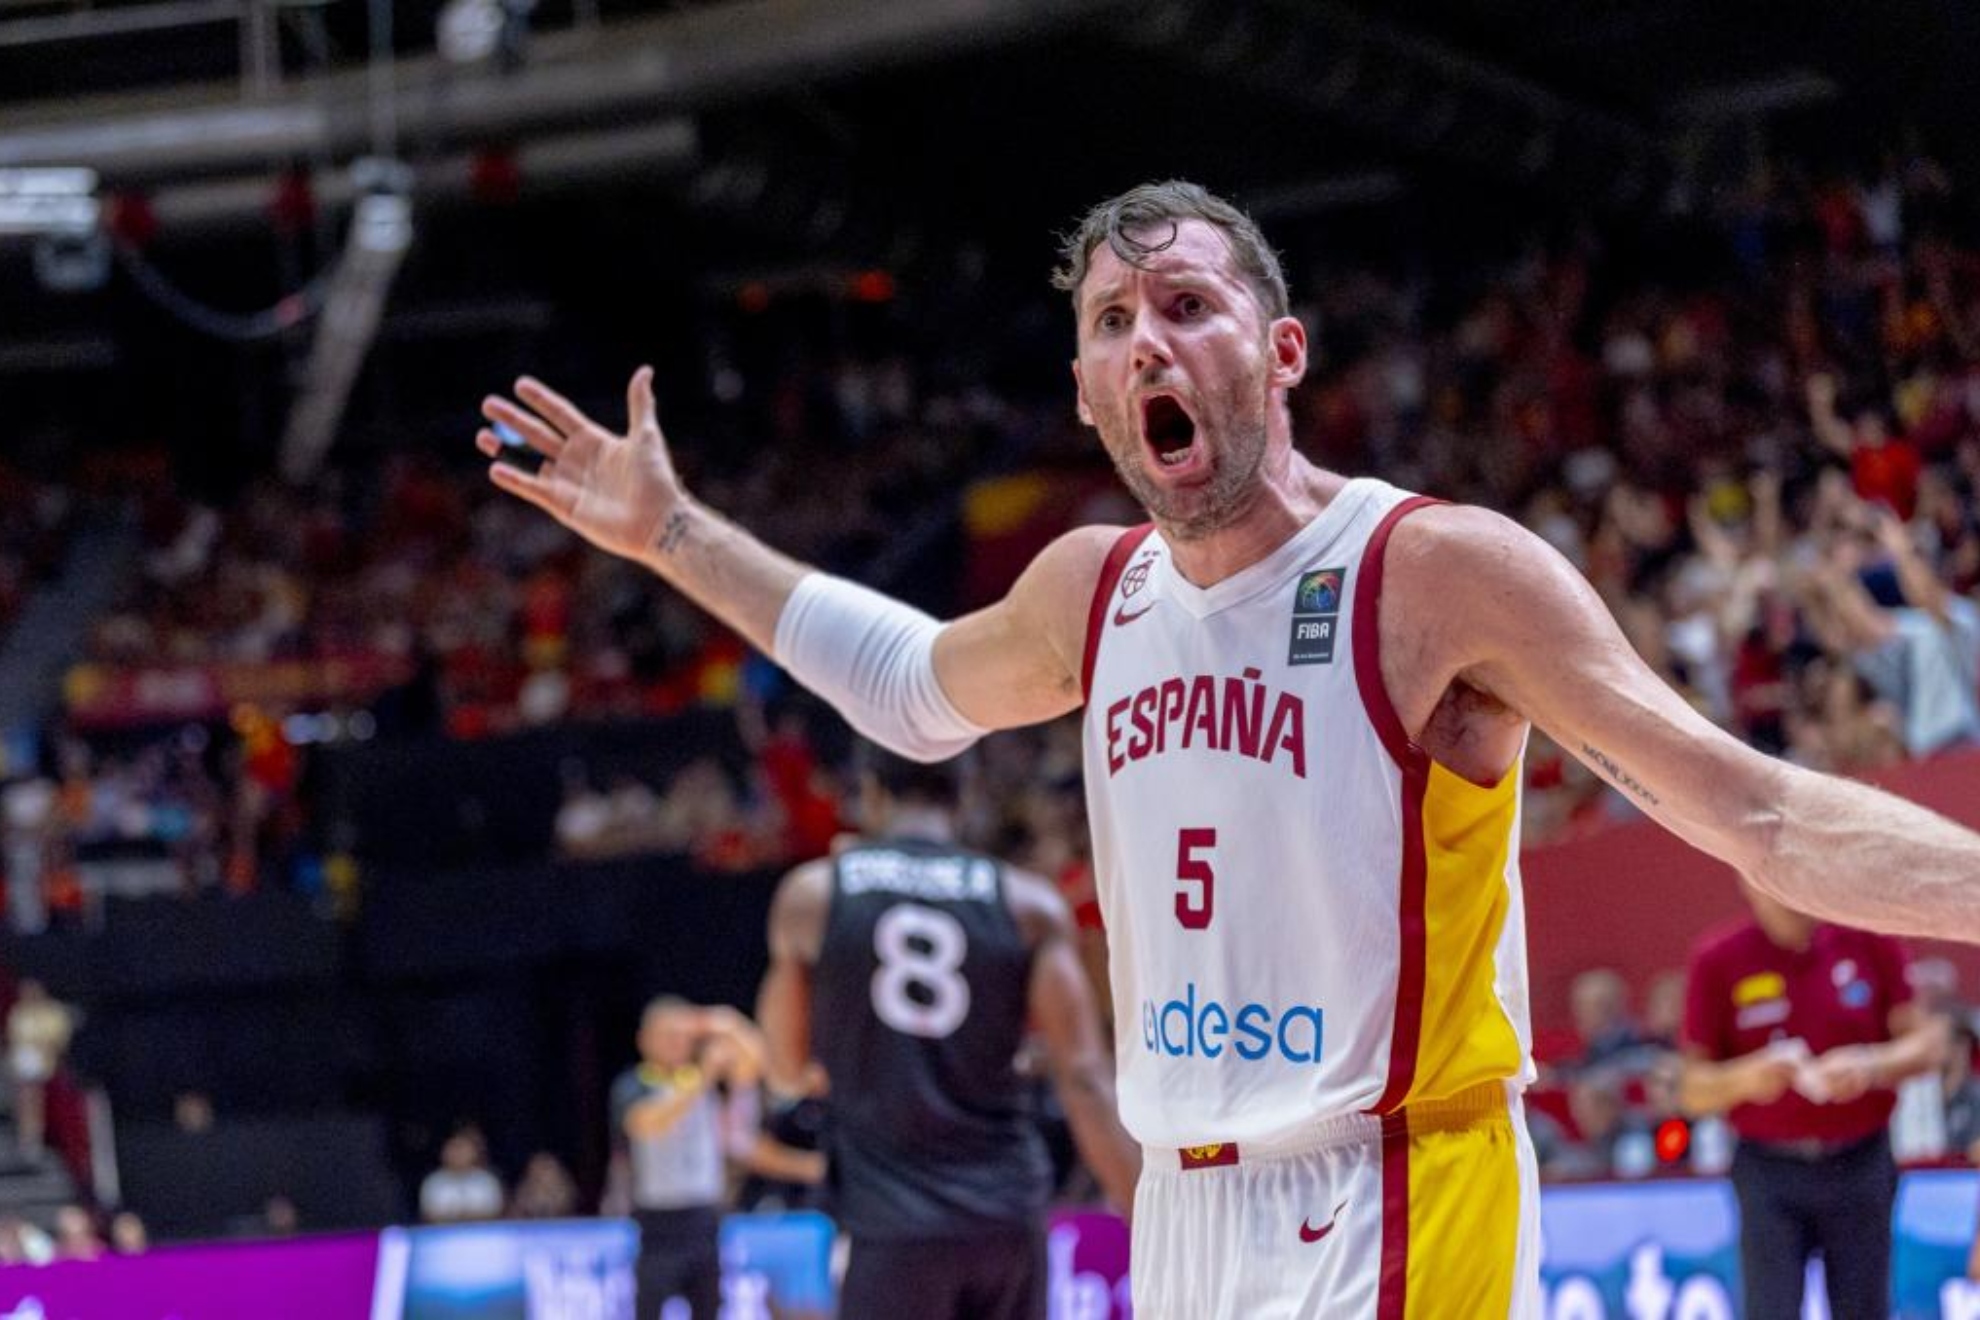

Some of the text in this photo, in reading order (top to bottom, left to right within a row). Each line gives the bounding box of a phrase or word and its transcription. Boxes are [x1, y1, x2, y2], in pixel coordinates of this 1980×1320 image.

[1297, 622, 1330, 640] FIBA
[1107, 666, 1306, 779] ESPAÑA
[1174, 828, 1216, 930] 5
[869, 902, 971, 1039] 8
